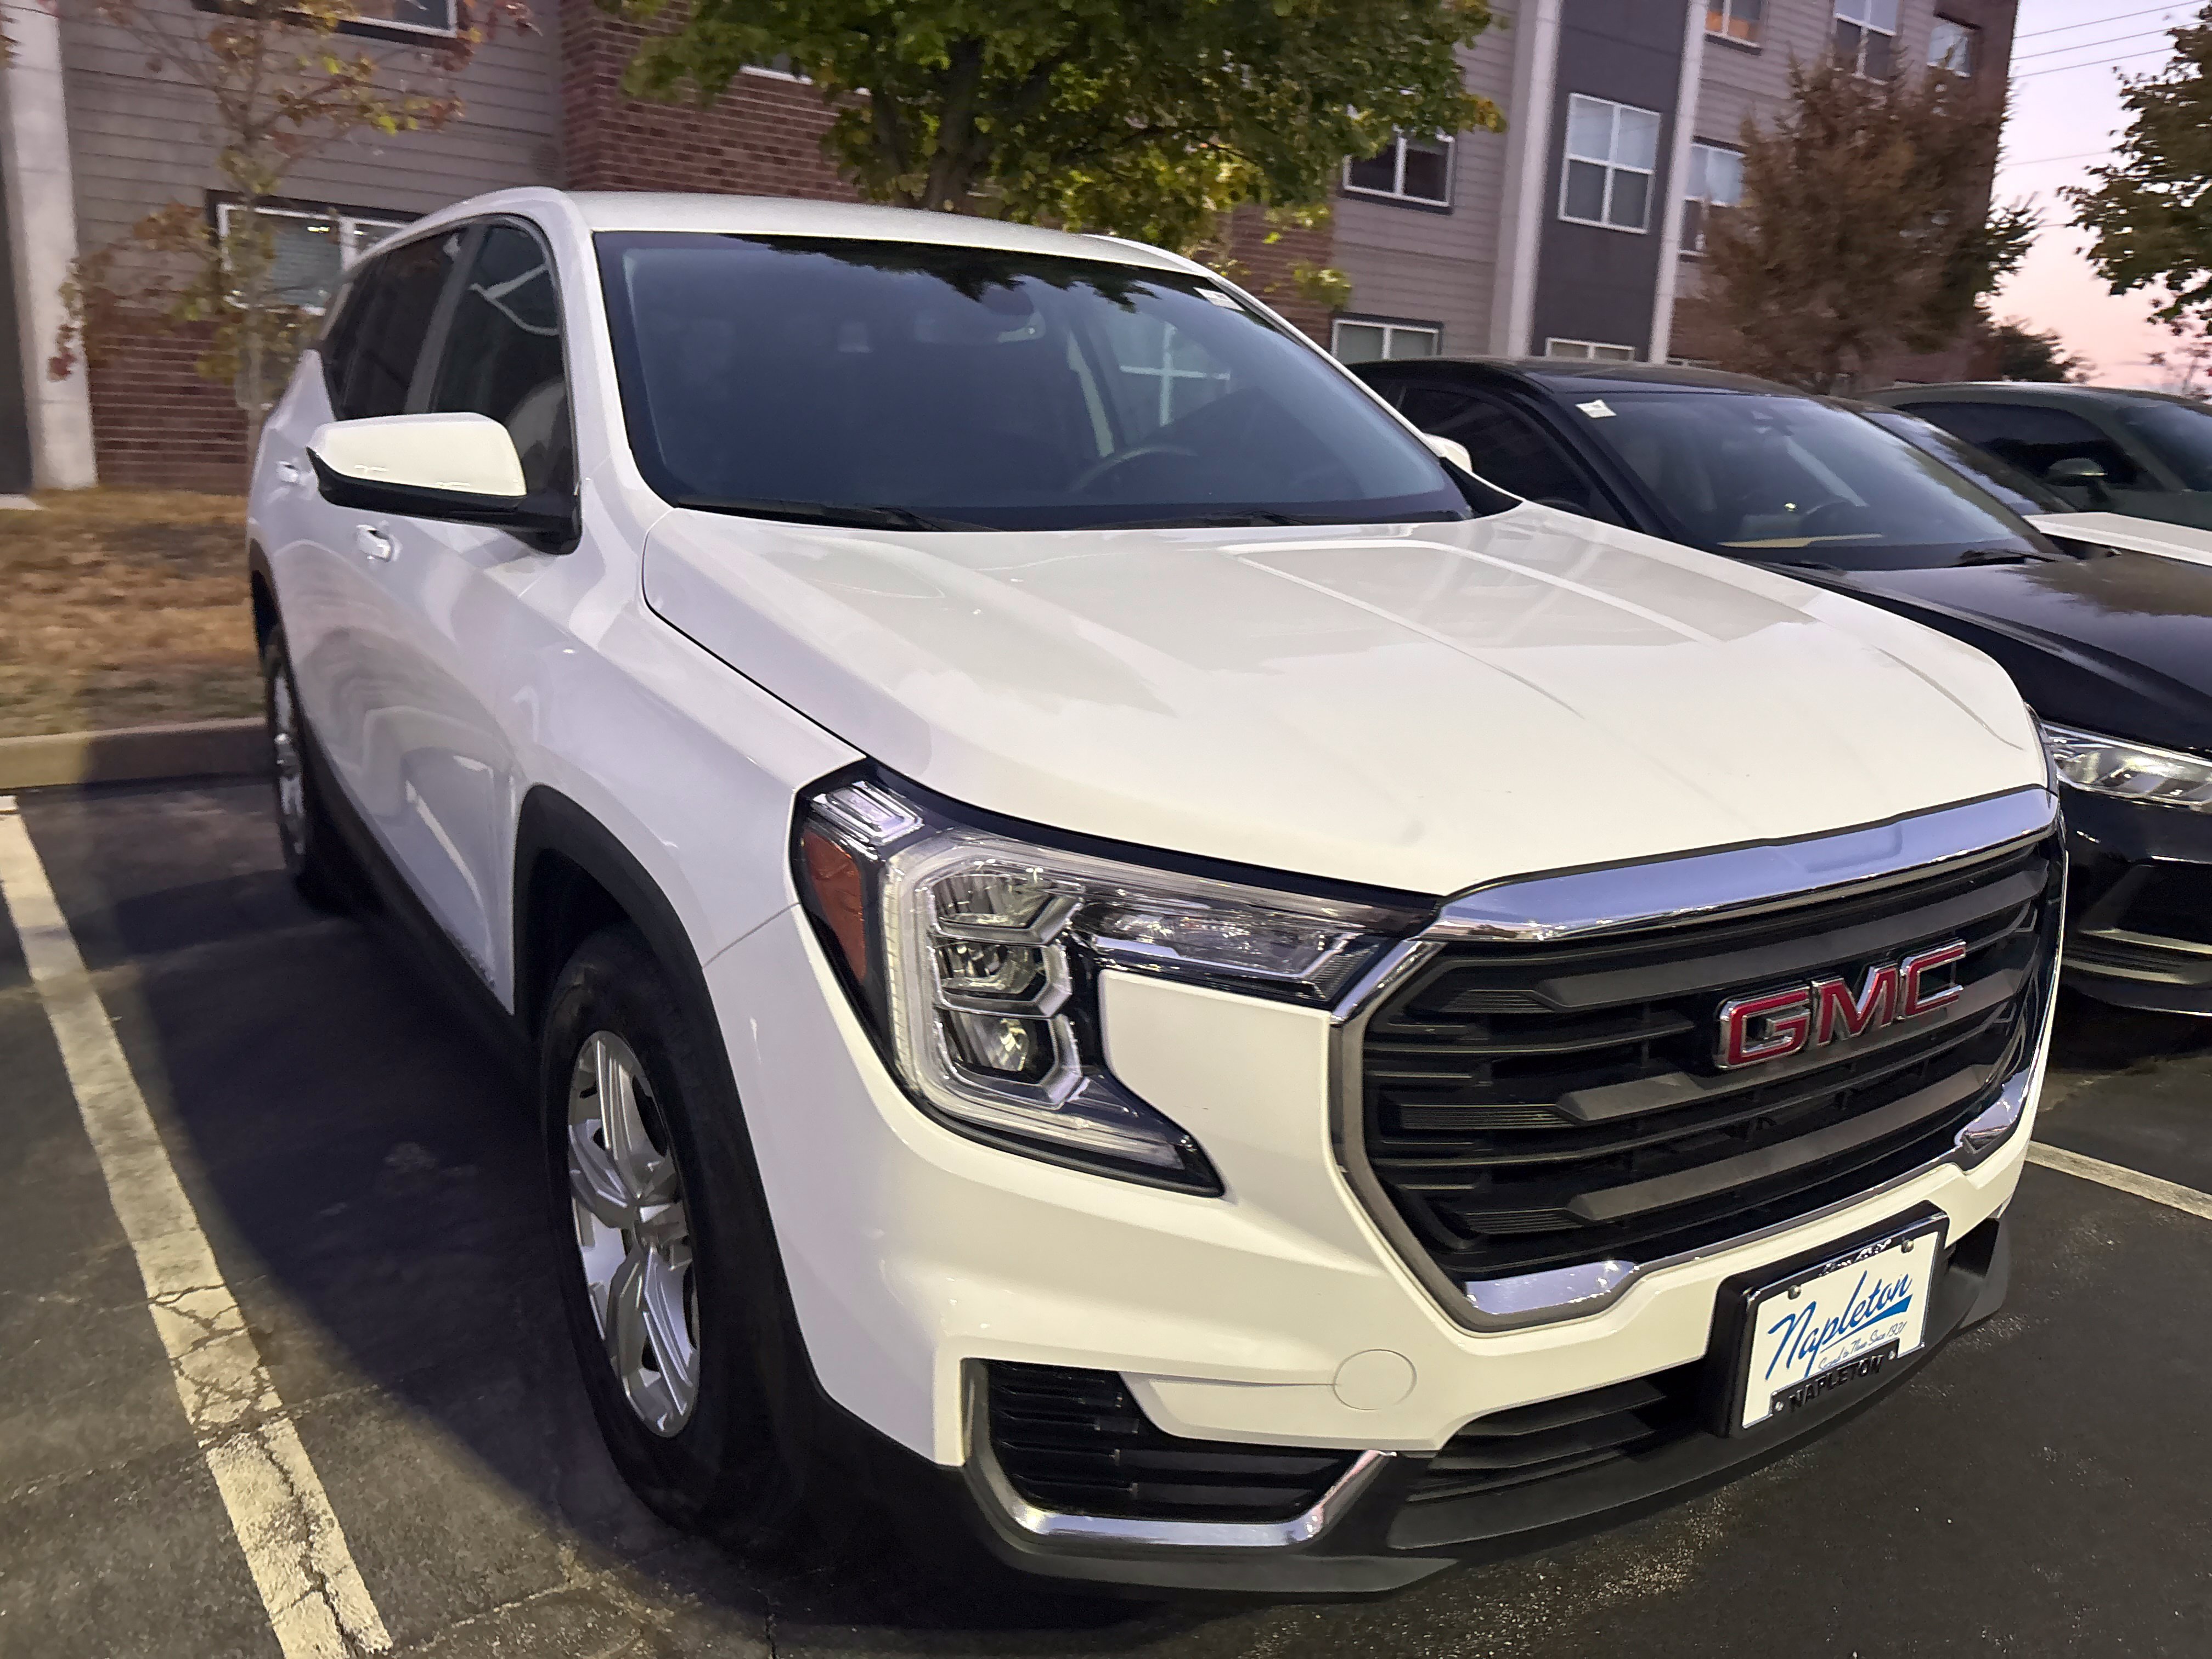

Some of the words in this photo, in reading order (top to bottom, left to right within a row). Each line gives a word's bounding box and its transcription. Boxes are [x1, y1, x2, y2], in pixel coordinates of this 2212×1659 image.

[1714, 940, 1966, 1069] GMC
[1765, 1269, 1912, 1380] Napleton
[1788, 1355, 1885, 1412] NAPLETON
